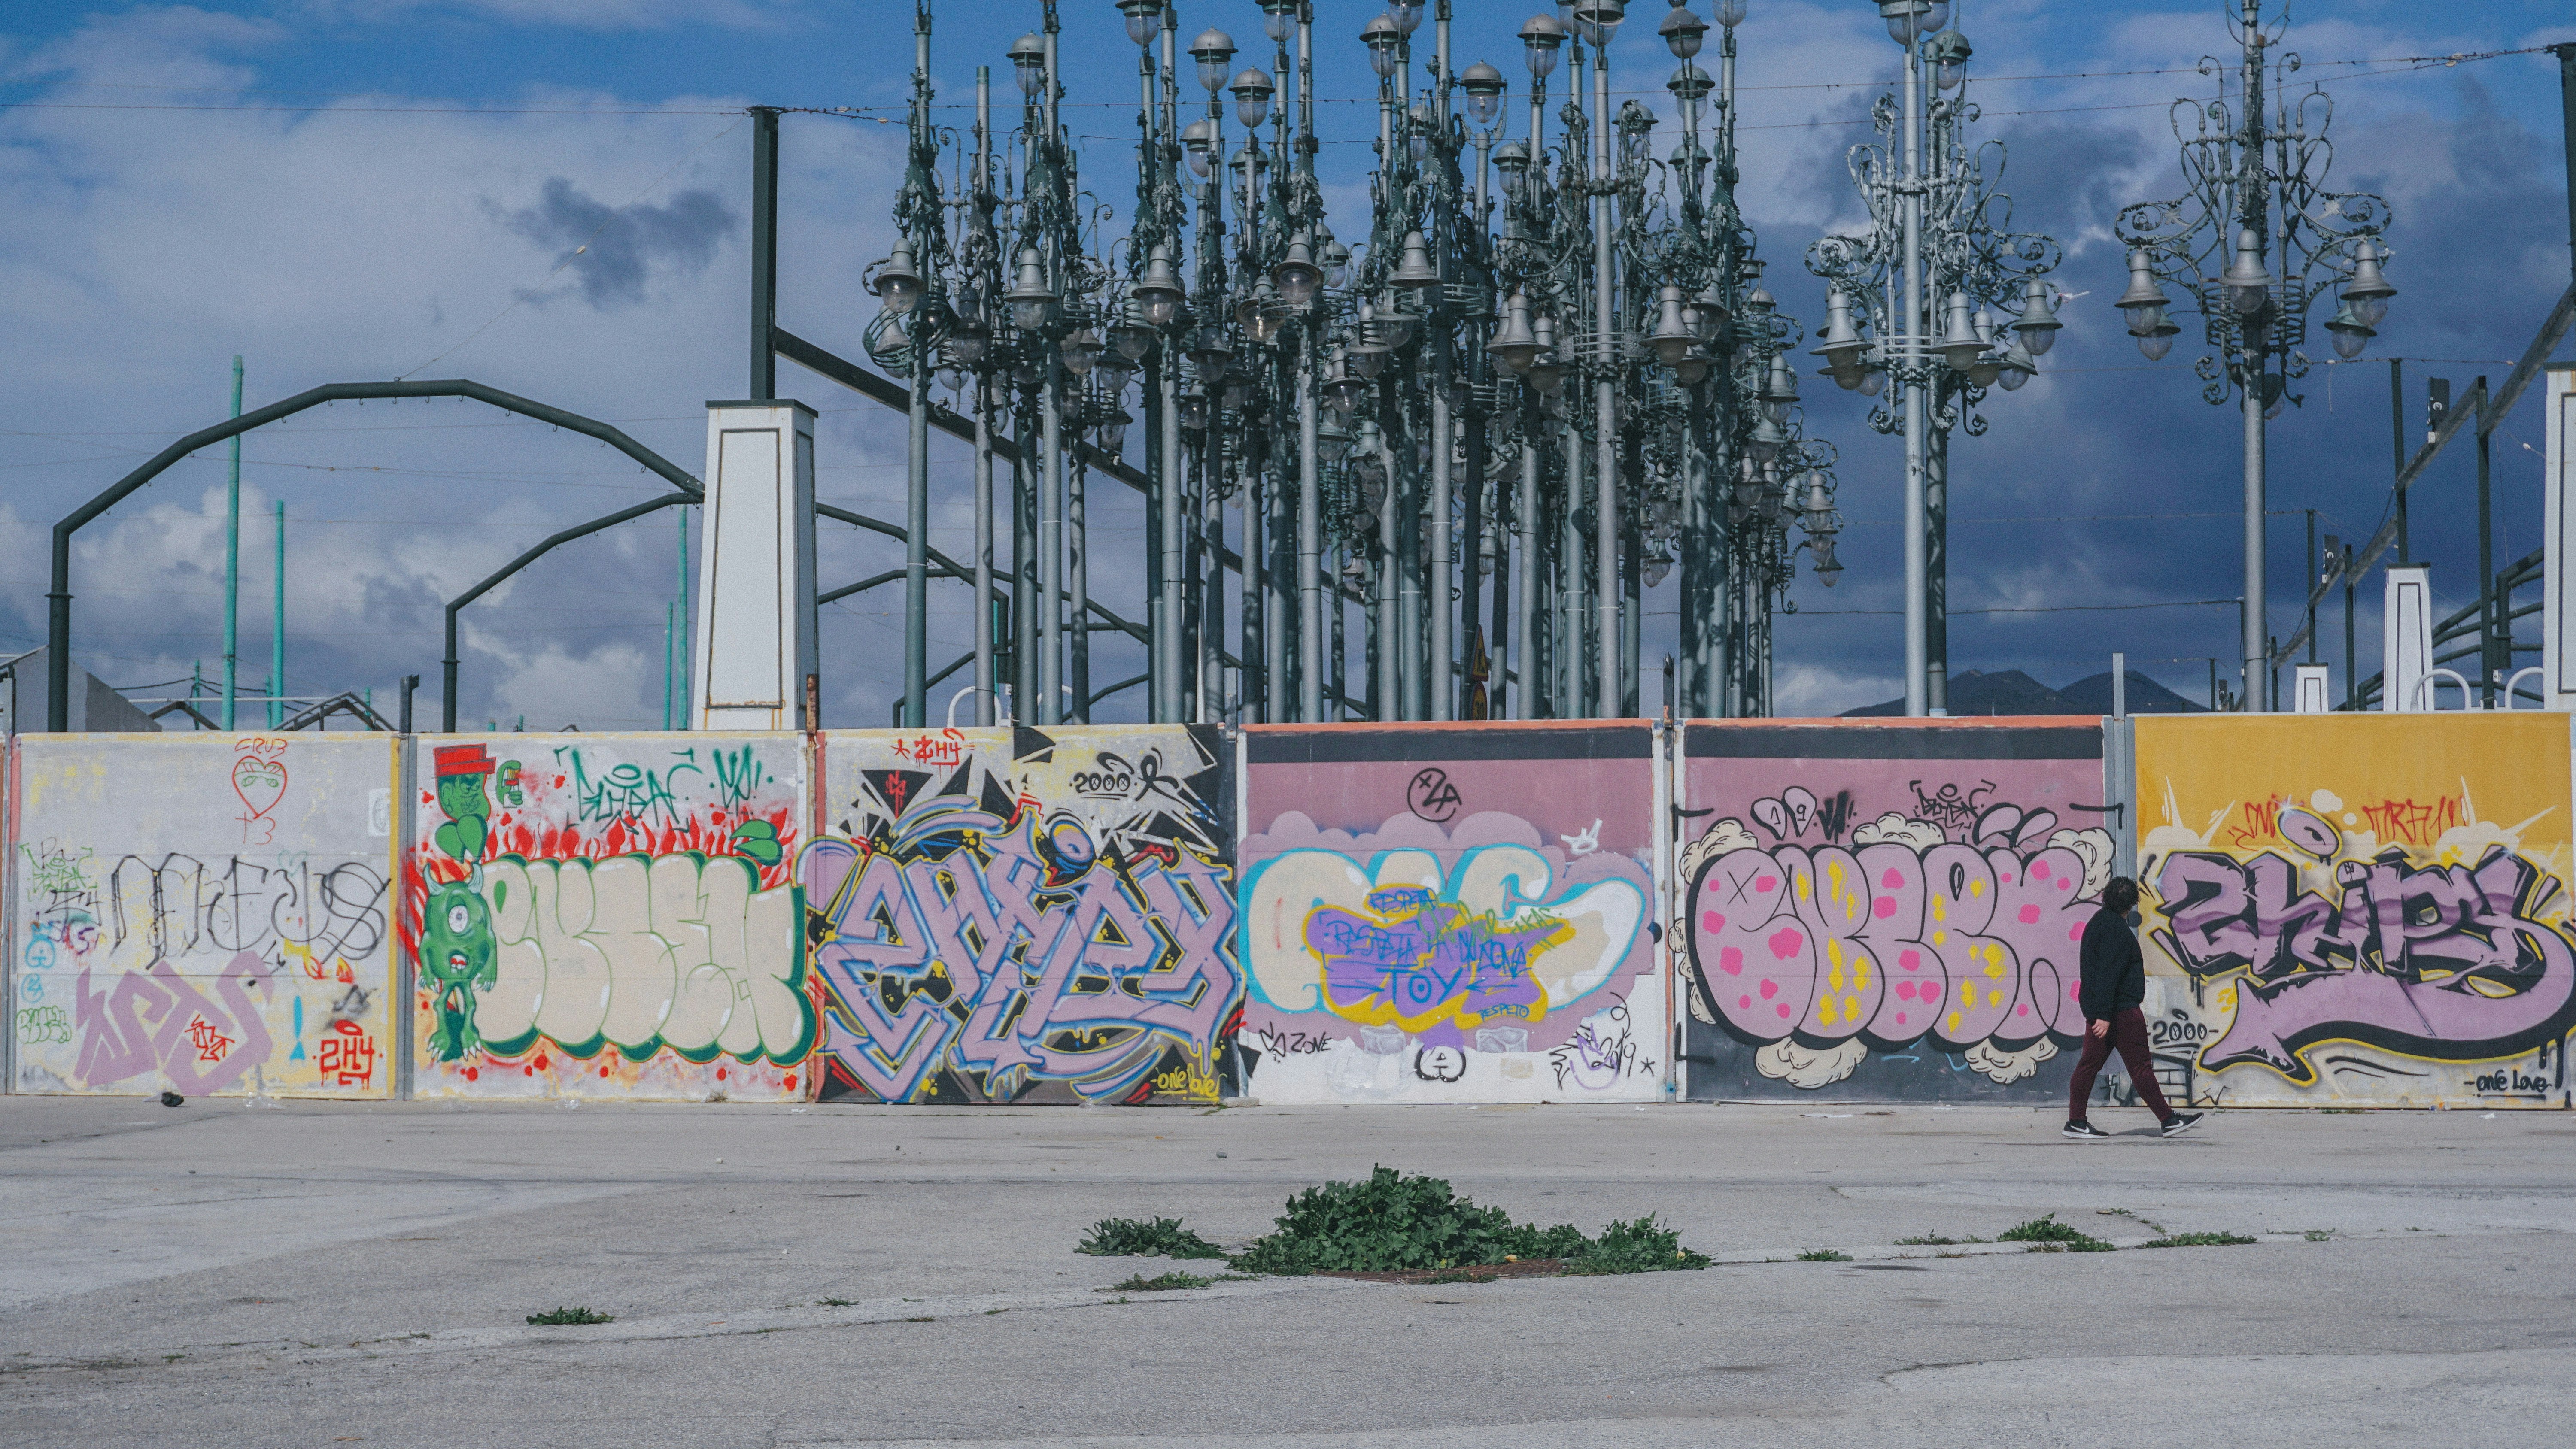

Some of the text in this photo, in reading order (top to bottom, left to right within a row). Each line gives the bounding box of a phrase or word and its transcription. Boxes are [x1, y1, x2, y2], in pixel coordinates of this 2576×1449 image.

[1073, 772, 1130, 793] 2000
[1376, 967, 1461, 1006] TOY
[1291, 1031, 1333, 1054] ZONE
[2152, 1020, 2208, 1045] 2000
